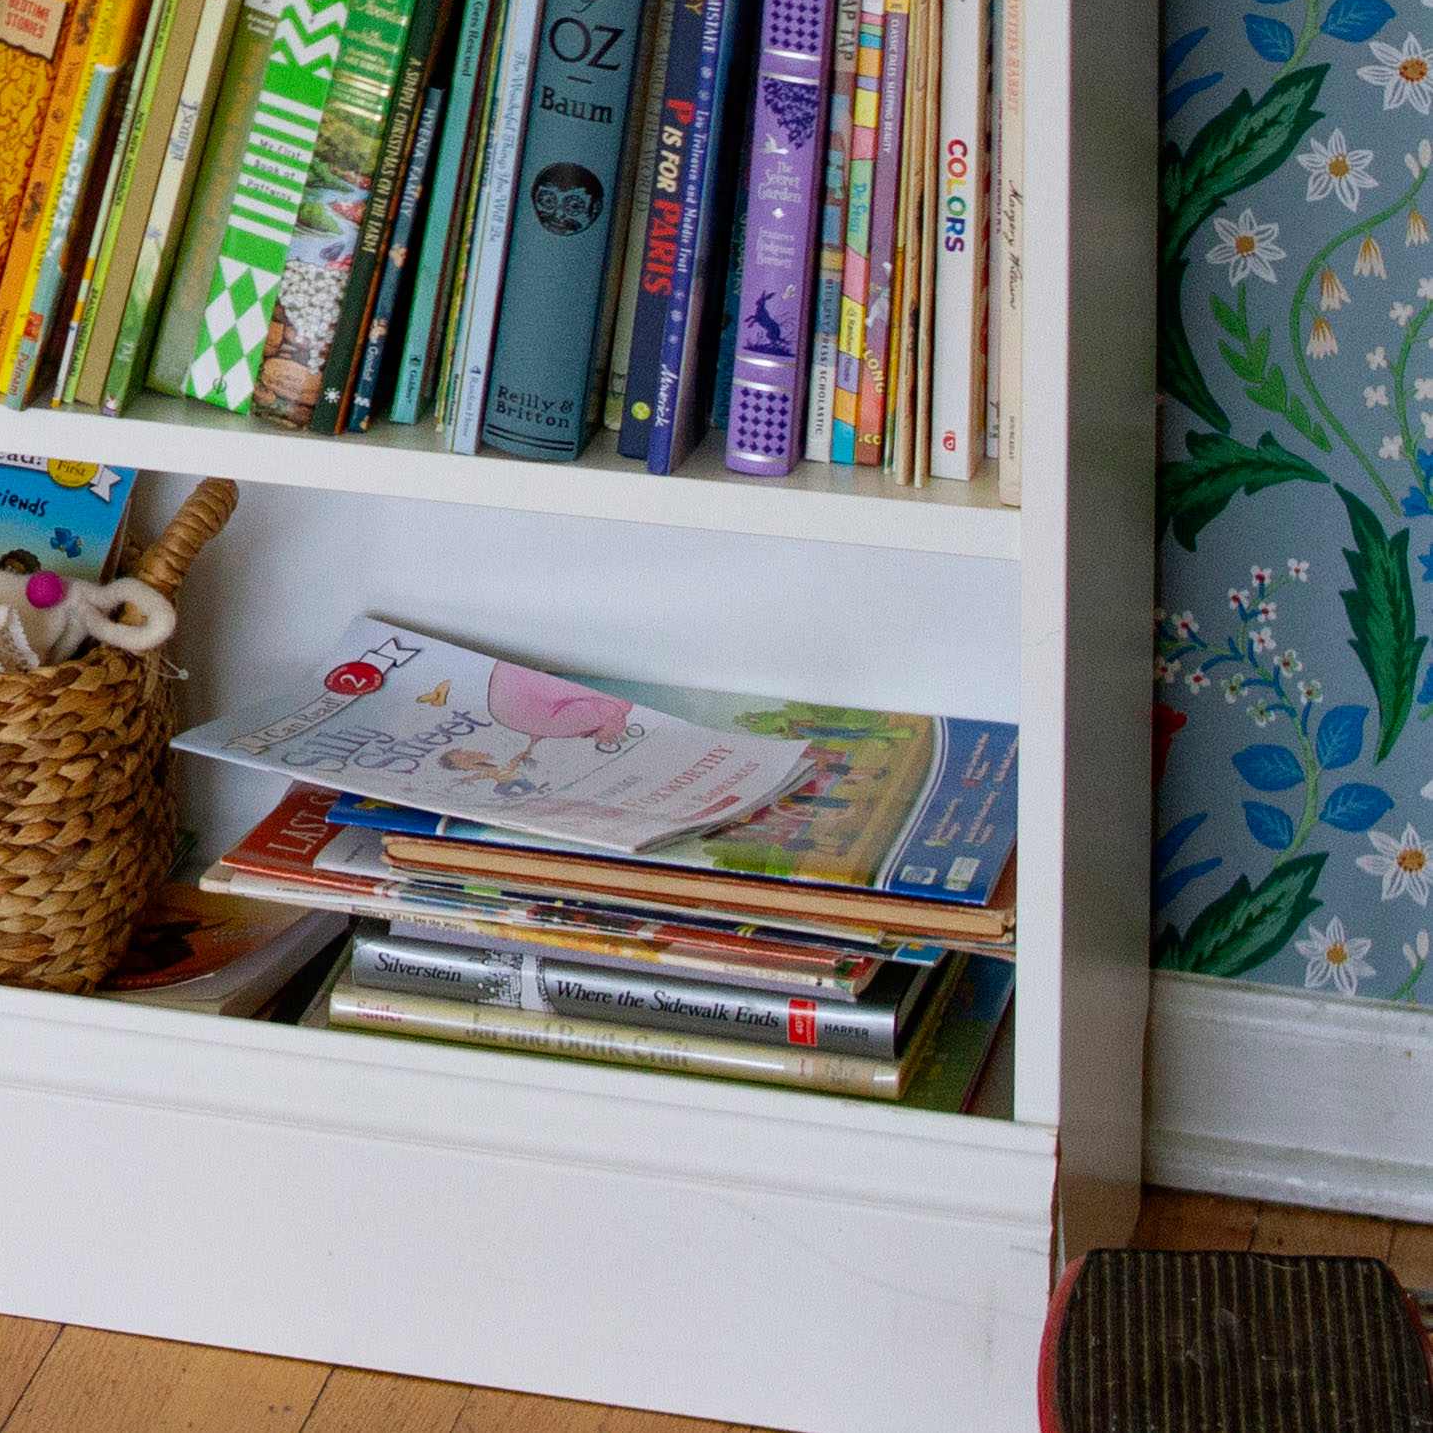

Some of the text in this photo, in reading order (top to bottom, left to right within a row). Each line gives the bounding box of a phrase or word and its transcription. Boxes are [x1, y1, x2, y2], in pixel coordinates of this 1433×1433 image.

[4, 11, 47, 39] STORIES
[548, 17, 626, 70] OZ
[838, 27, 855, 61] TAP
[539, 86, 613, 125] Baum
[1005, 57, 1020, 115] RABBIT
[399, 108, 437, 217] HYENA FAMILY
[641, 97, 696, 295] P IS FOR PARIS
[758, 183, 802, 204] Garden
[944, 138, 968, 253] COLORS
[494, 399, 571, 430] Britton
[497, 385, 575, 414] Reilly &
[654, 363, 679, 428] Maverick
[283, 723, 395, 774] Silly
[353, 709, 493, 775] Street
[619, 744, 733, 811] FOXWORTHY
[373, 951, 462, 984] Silverstein
[556, 979, 780, 1030] Where the Sidewalk Ends
[823, 1023, 871, 1039] HARPER
